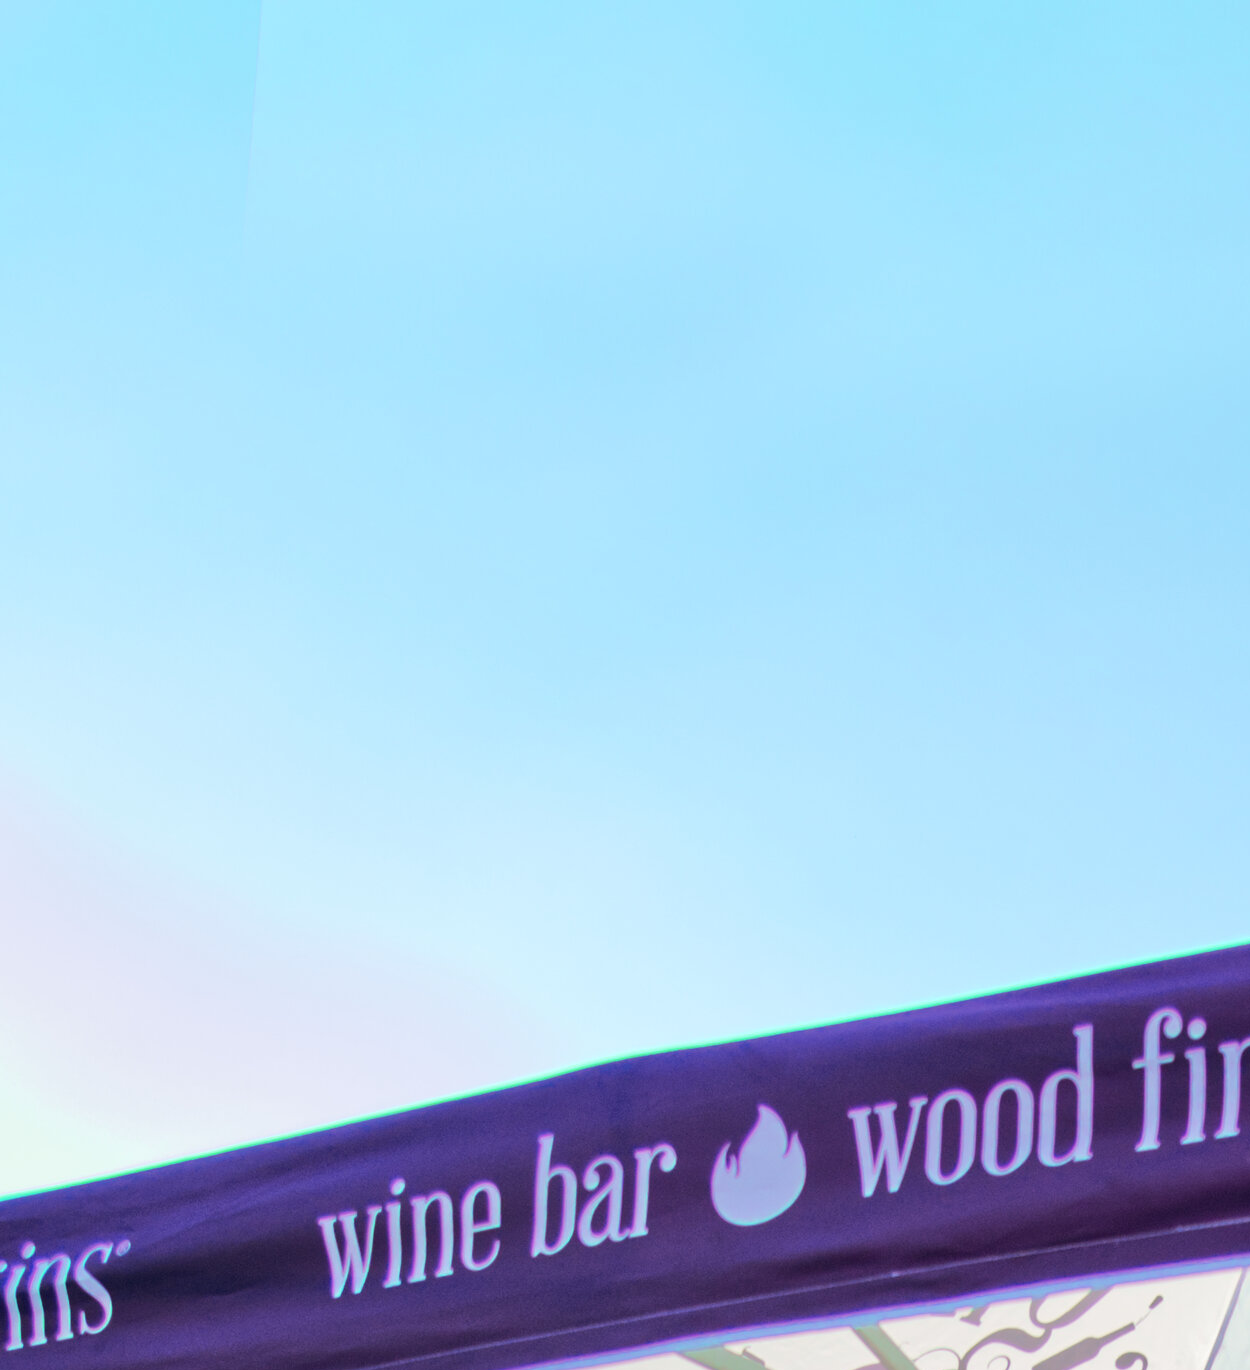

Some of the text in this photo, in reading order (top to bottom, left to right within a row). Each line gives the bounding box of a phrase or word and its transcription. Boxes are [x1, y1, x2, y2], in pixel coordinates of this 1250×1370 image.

[318, 1178, 502, 1299] wine
[530, 1133, 677, 1258] bar
[848, 1023, 1094, 1198] wood
